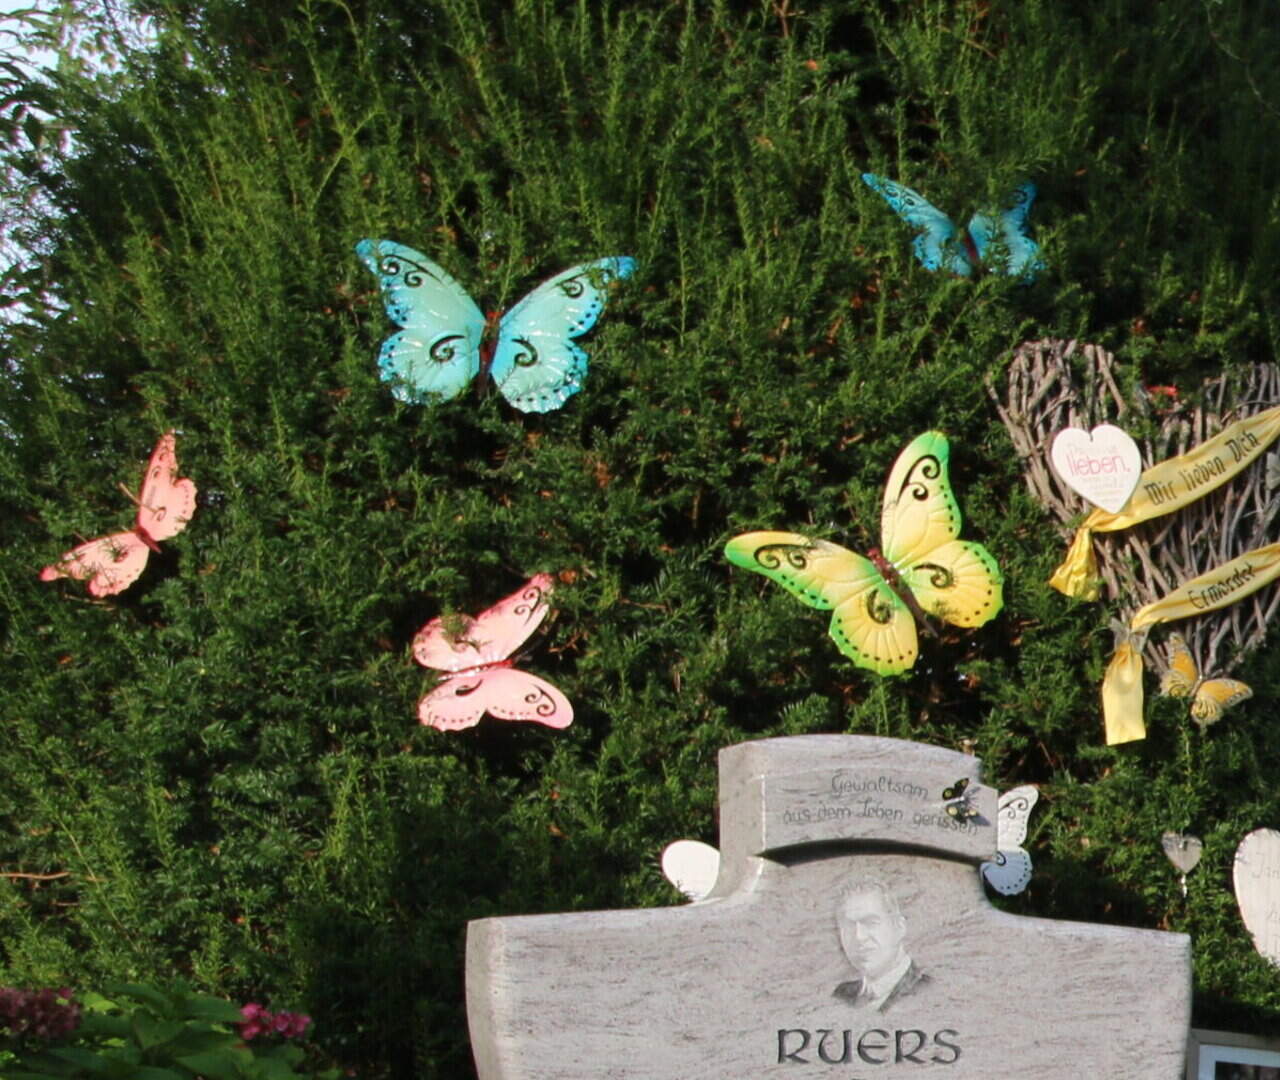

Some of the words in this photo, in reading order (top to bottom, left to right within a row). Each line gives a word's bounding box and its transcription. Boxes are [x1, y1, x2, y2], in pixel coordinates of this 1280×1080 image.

[1144, 479, 1178, 506] Wir
[1178, 454, 1226, 492] lieben
[1224, 430, 1261, 462] Dich
[831, 771, 929, 800] Gewaltsam
[783, 808, 811, 825] aus
[816, 803, 851, 821] dem
[856, 797, 904, 821] Leben
[776, 1027, 963, 1066] RUERS
